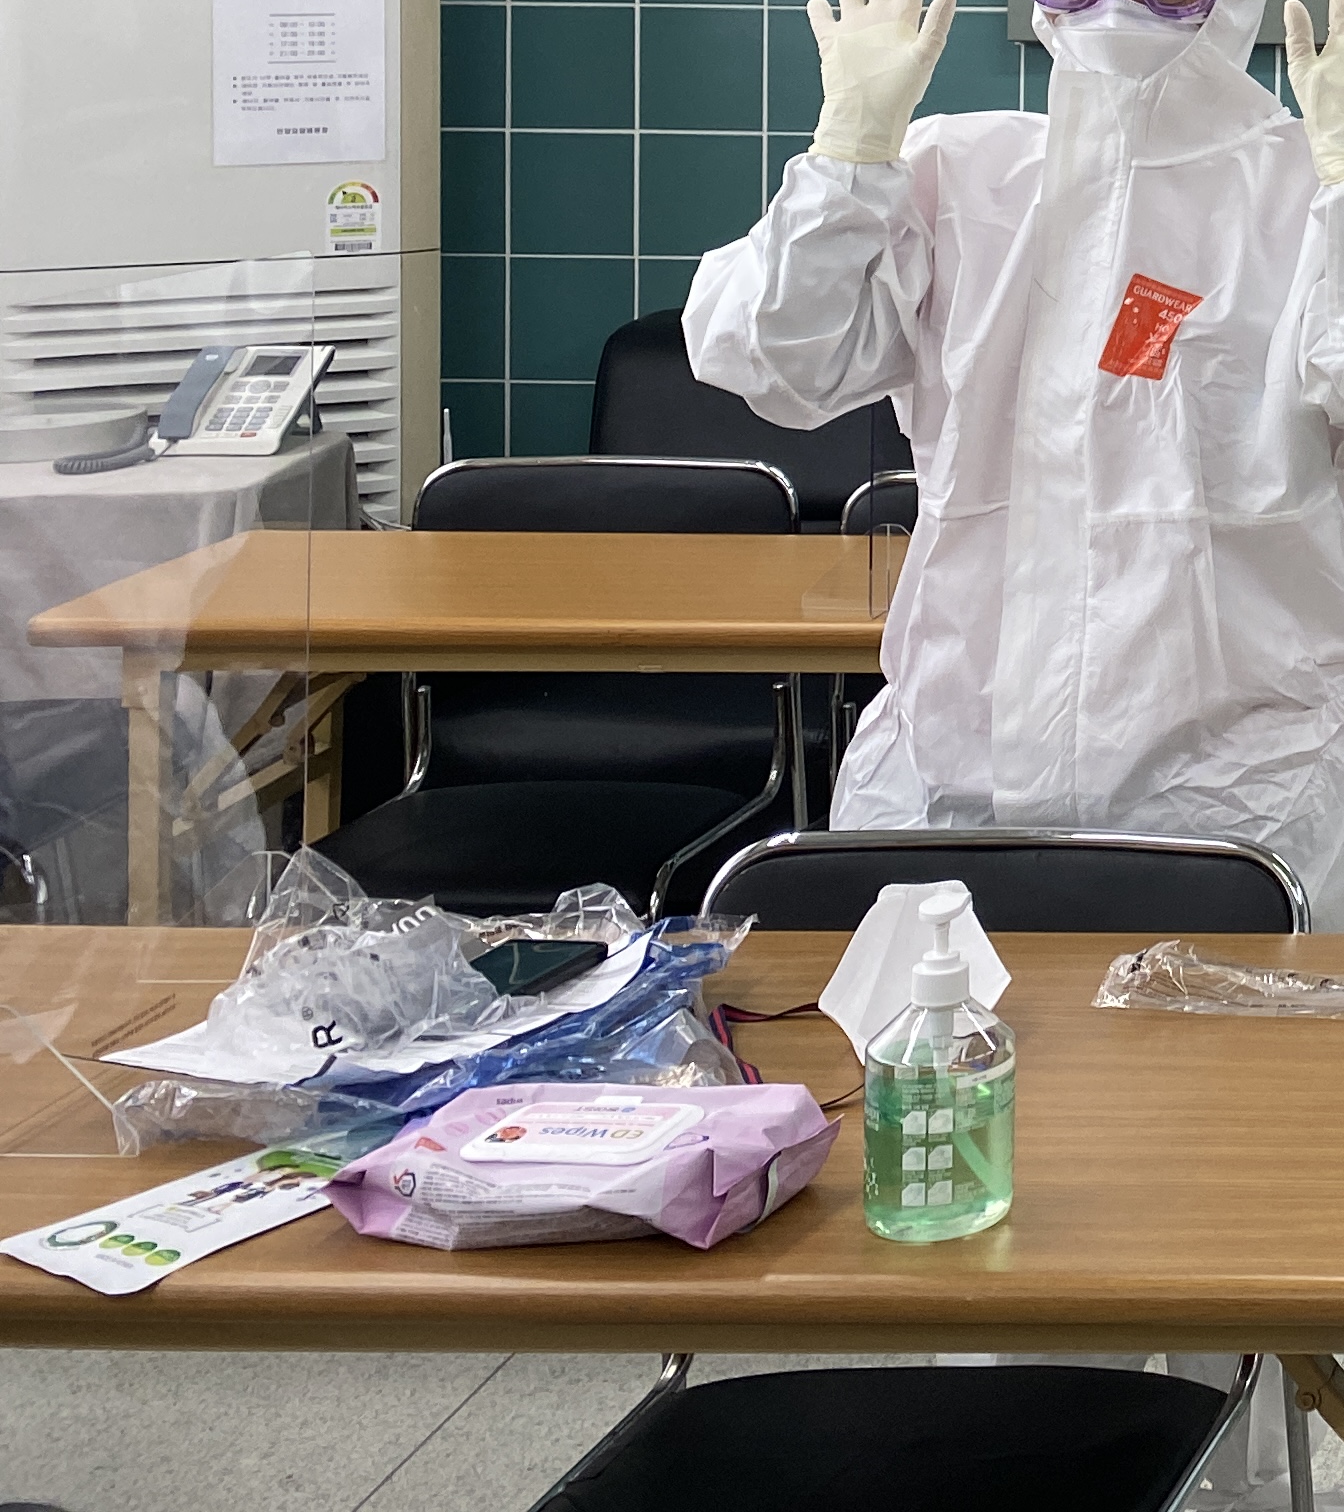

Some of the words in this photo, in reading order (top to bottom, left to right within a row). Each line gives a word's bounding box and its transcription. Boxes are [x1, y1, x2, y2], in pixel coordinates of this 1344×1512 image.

[1133, 285, 1193, 314] GUARDWEAR
[1158, 308, 1184, 324] 450
[538, 1126, 609, 1139] Wipes
